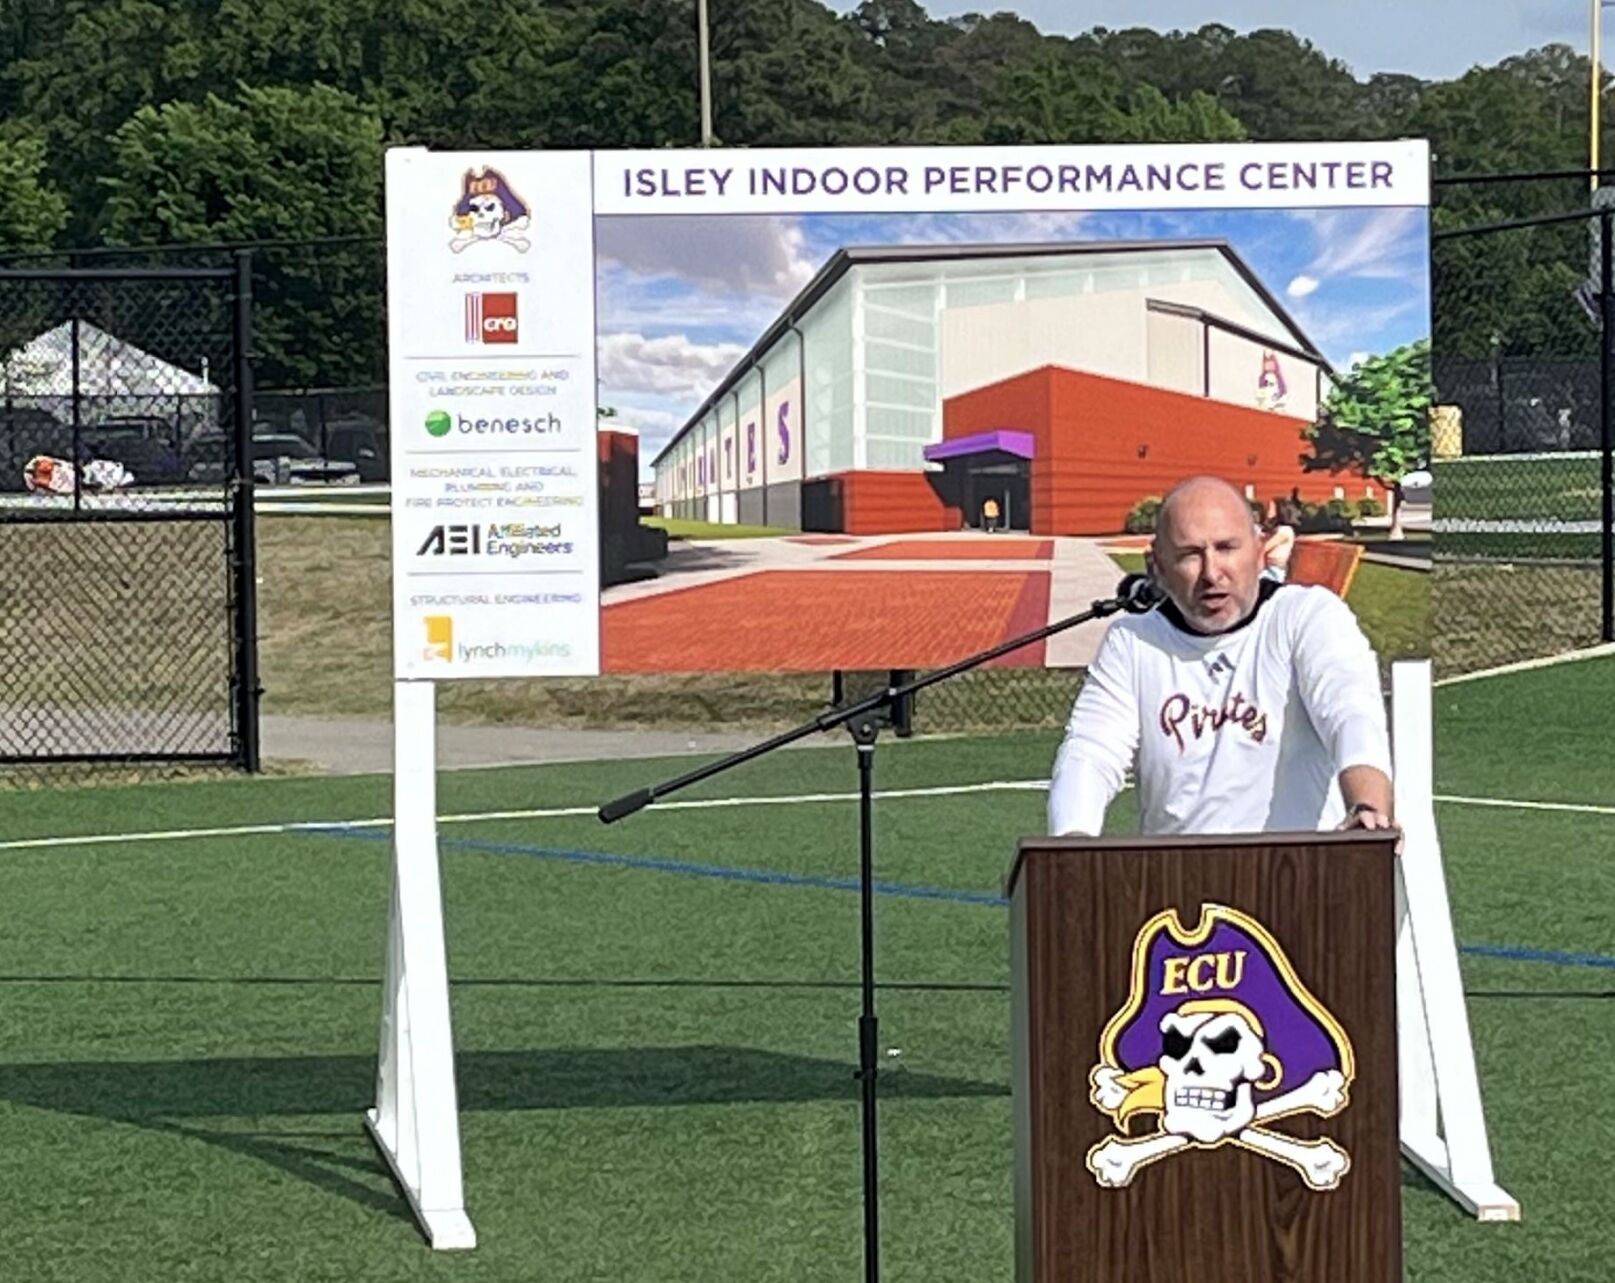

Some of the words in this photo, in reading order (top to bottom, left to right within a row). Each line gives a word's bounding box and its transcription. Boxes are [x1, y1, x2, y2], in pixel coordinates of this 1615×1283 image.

[623, 168, 734, 197] ISLEY
[749, 166, 909, 195] INDOOR
[924, 162, 1226, 194] PERFORMANCE
[1239, 161, 1394, 190] CENTER
[541, 369, 570, 381] AND
[429, 385, 505, 397] LANDSCAPE
[509, 384, 557, 396] DESIGN
[458, 413, 561, 434] benesch
[515, 481, 544, 492] AND
[405, 497, 433, 508] FIRE
[487, 522, 561, 539] Affiliated
[486, 540, 574, 558] Engineers
[409, 594, 490, 606] STRUCTURAL
[494, 593, 583, 605] ENGINEERING
[1160, 951, 1247, 995] ECU
